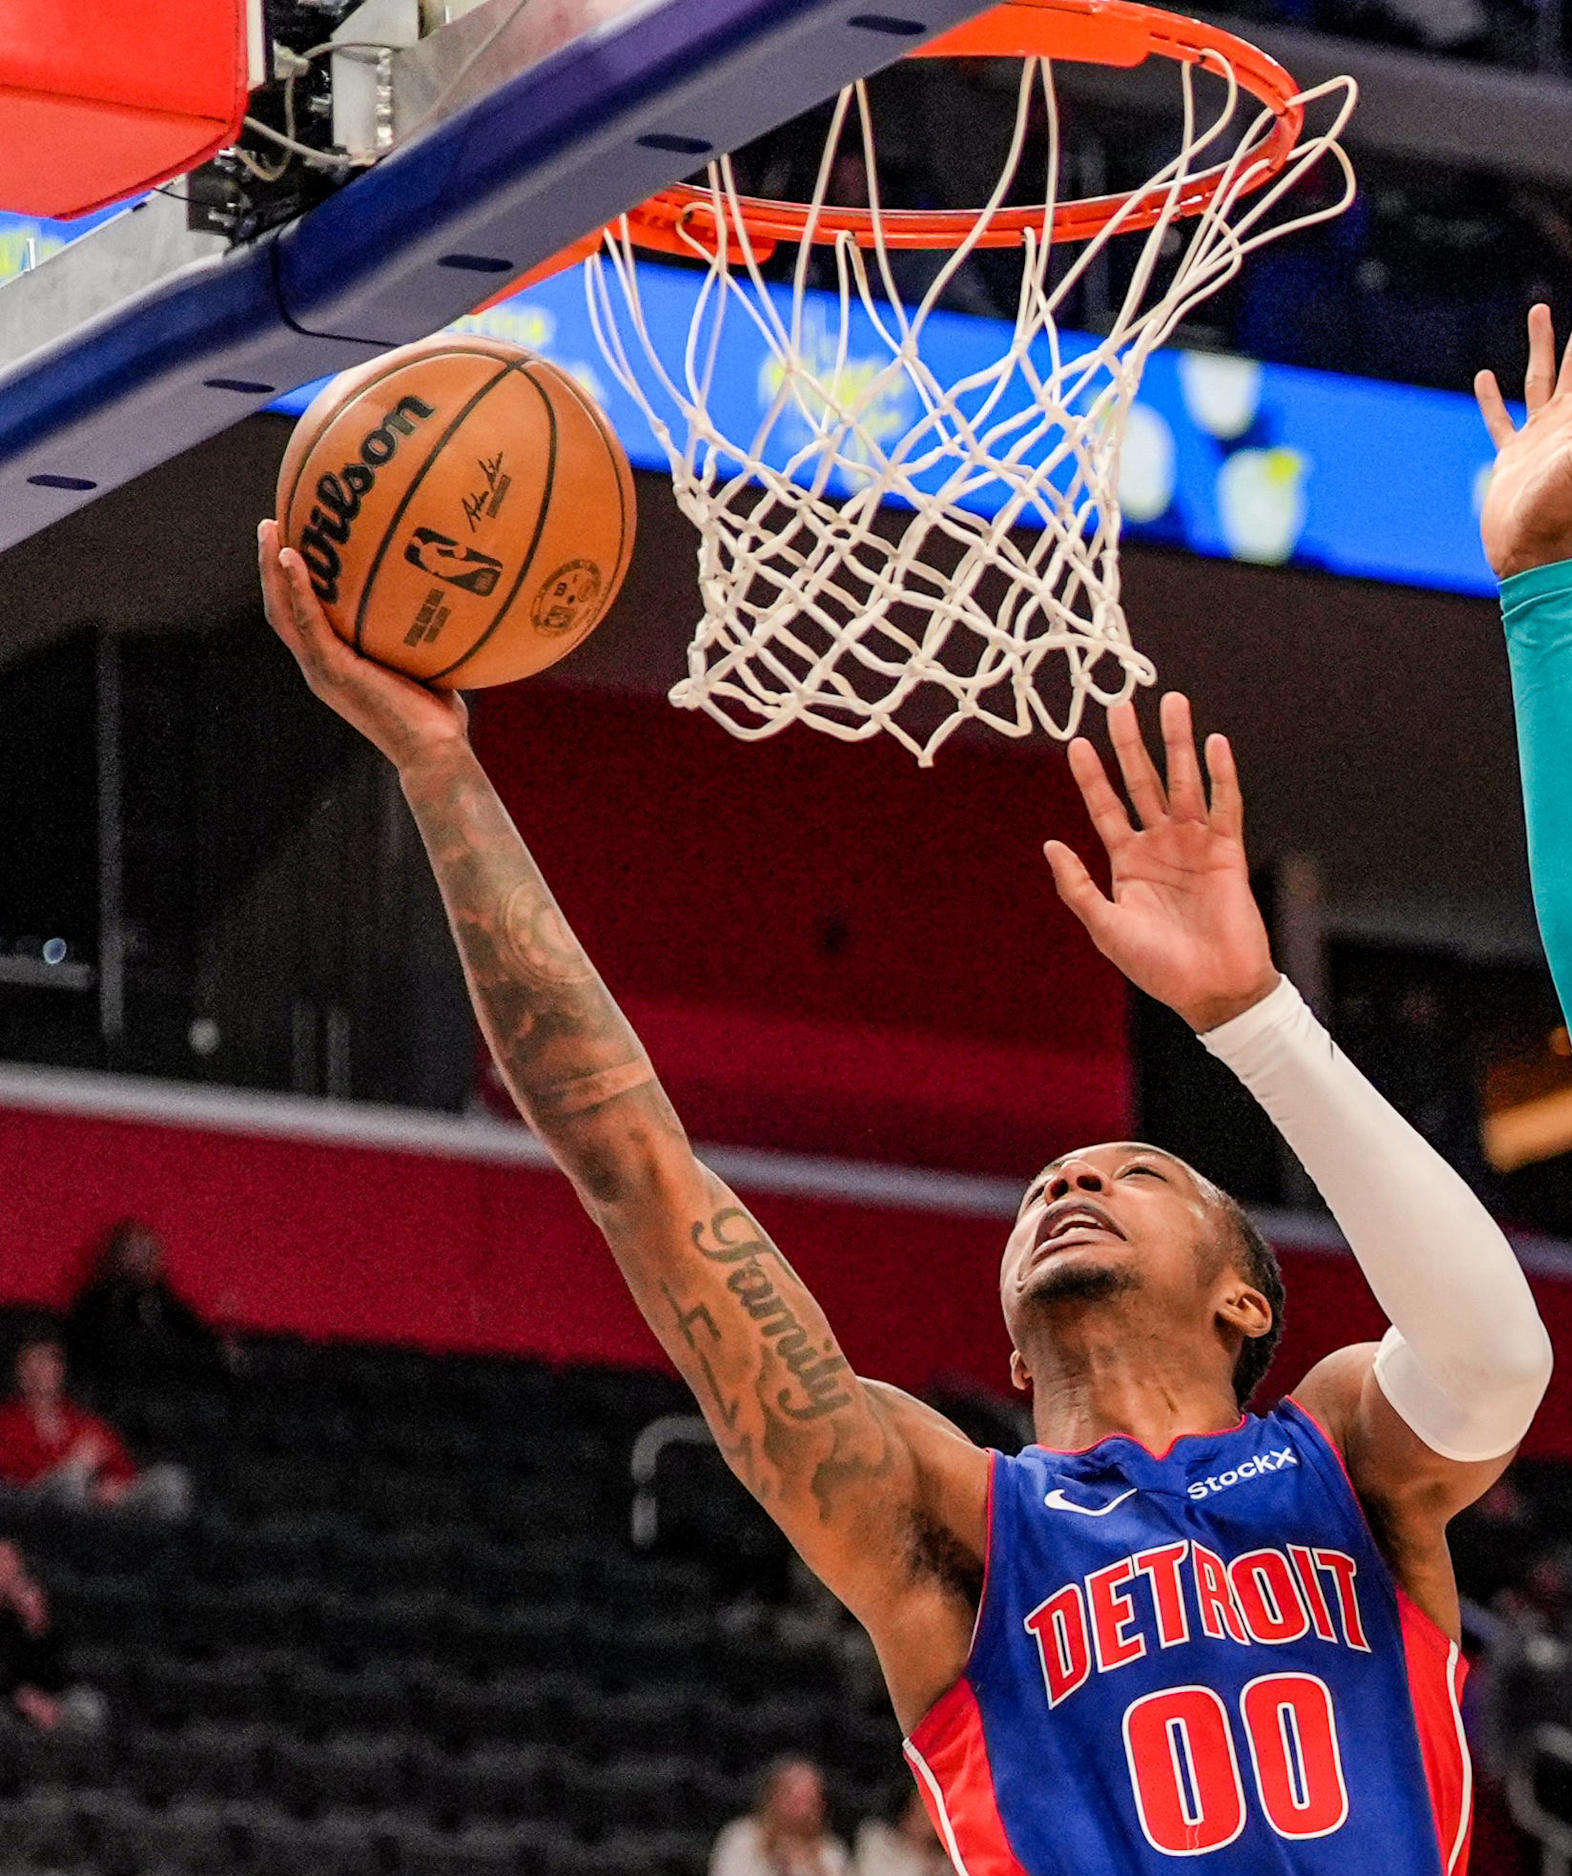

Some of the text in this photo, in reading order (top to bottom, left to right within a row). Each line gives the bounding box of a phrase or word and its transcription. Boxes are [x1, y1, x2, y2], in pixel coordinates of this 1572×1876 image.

[690, 1207, 853, 1421] Family
[1024, 1539, 1372, 1710] DETROIT
[1122, 1672, 1349, 1857] 00
